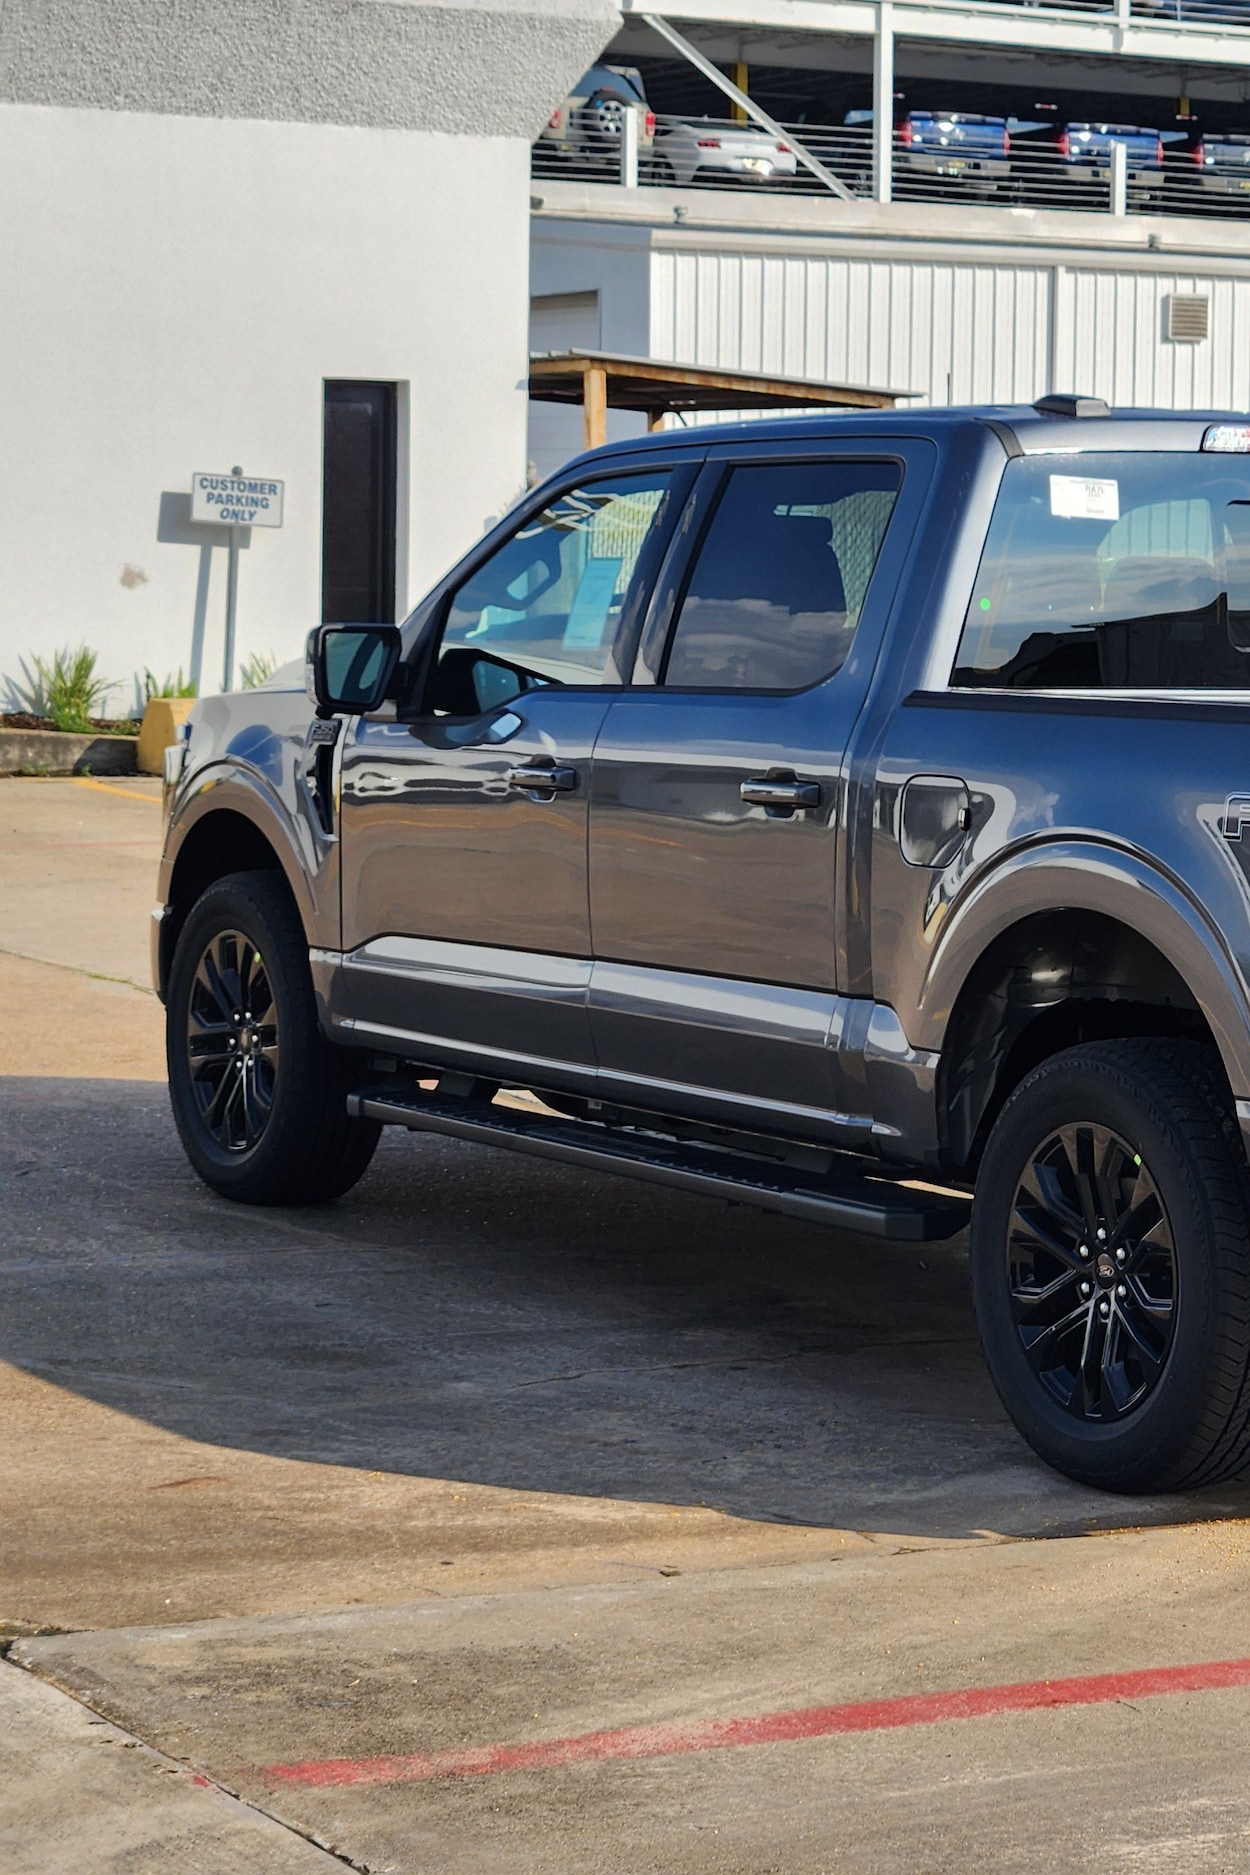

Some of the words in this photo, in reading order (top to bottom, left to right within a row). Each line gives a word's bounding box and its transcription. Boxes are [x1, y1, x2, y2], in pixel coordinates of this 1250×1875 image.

[199, 477, 278, 496] CUSTOMER
[206, 492, 270, 509] PARKING
[220, 508, 257, 522] ONLY
